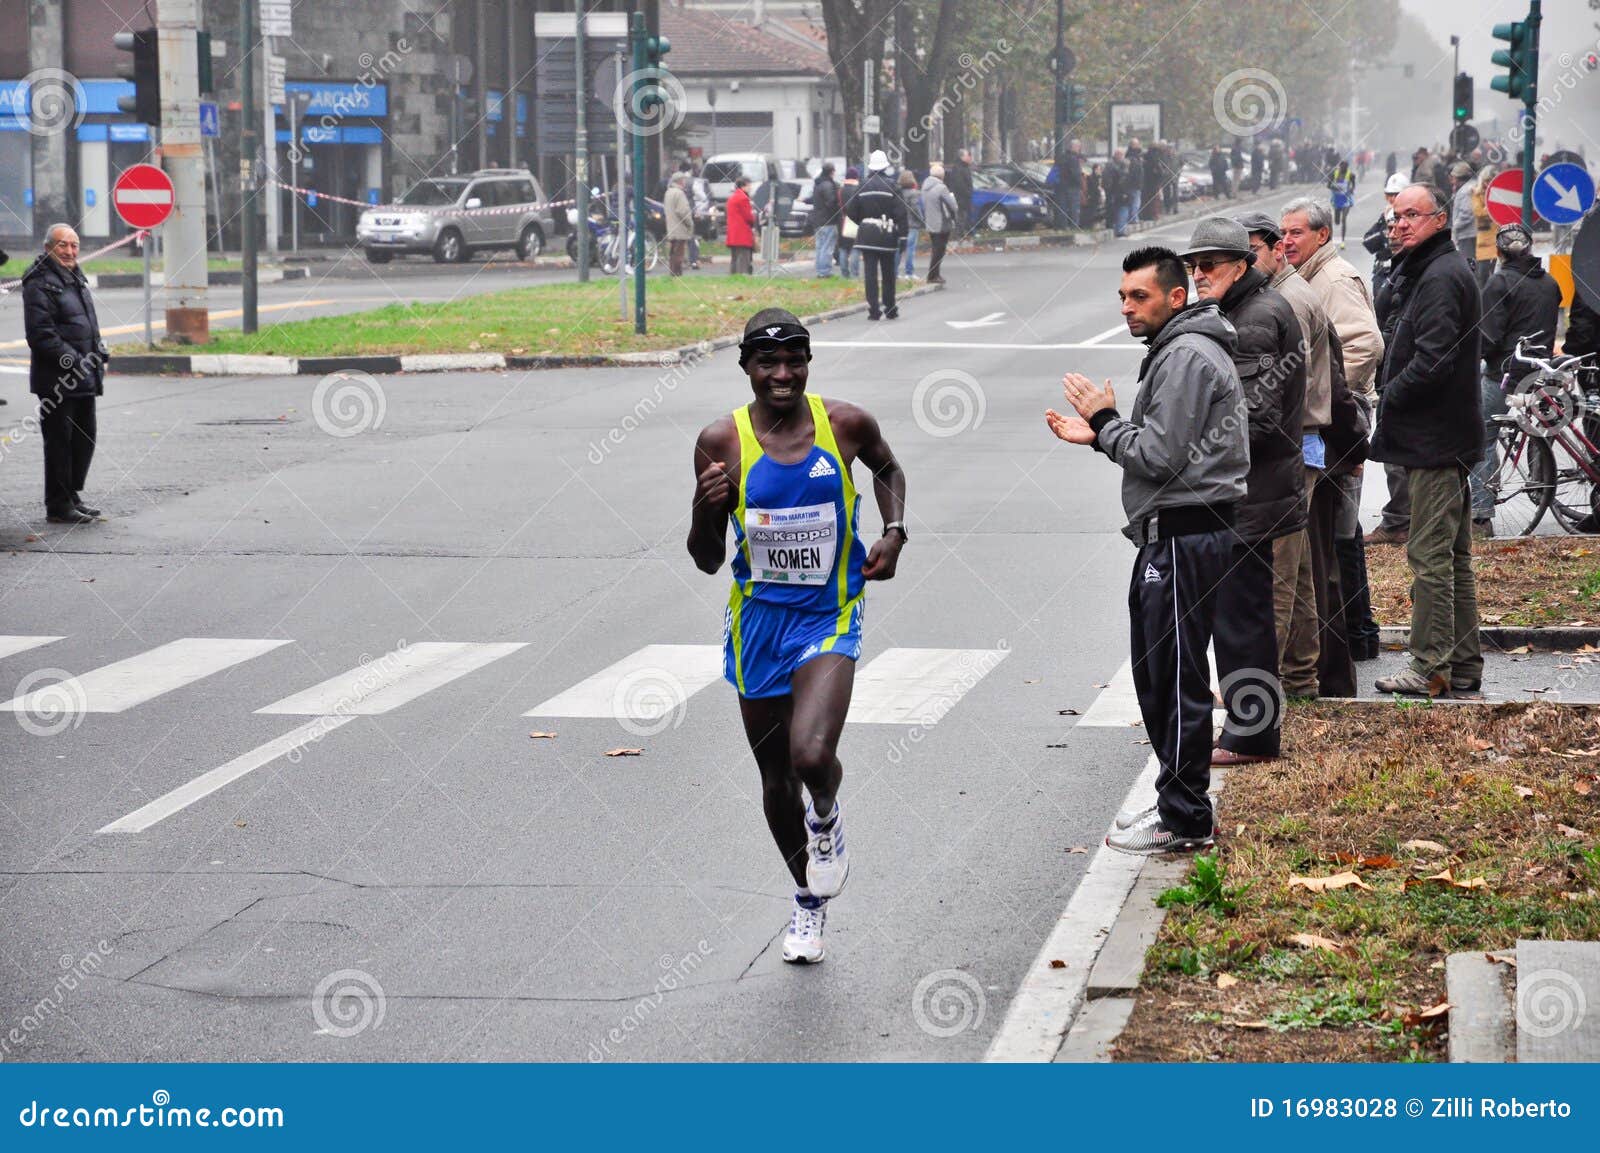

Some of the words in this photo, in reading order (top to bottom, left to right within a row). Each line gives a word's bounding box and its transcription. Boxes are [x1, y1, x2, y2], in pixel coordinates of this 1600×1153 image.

[309, 90, 370, 109] ARCLAYS
[808, 467, 836, 478] adidas
[773, 527, 832, 542] Kappa
[767, 546, 821, 569] KOMEN
